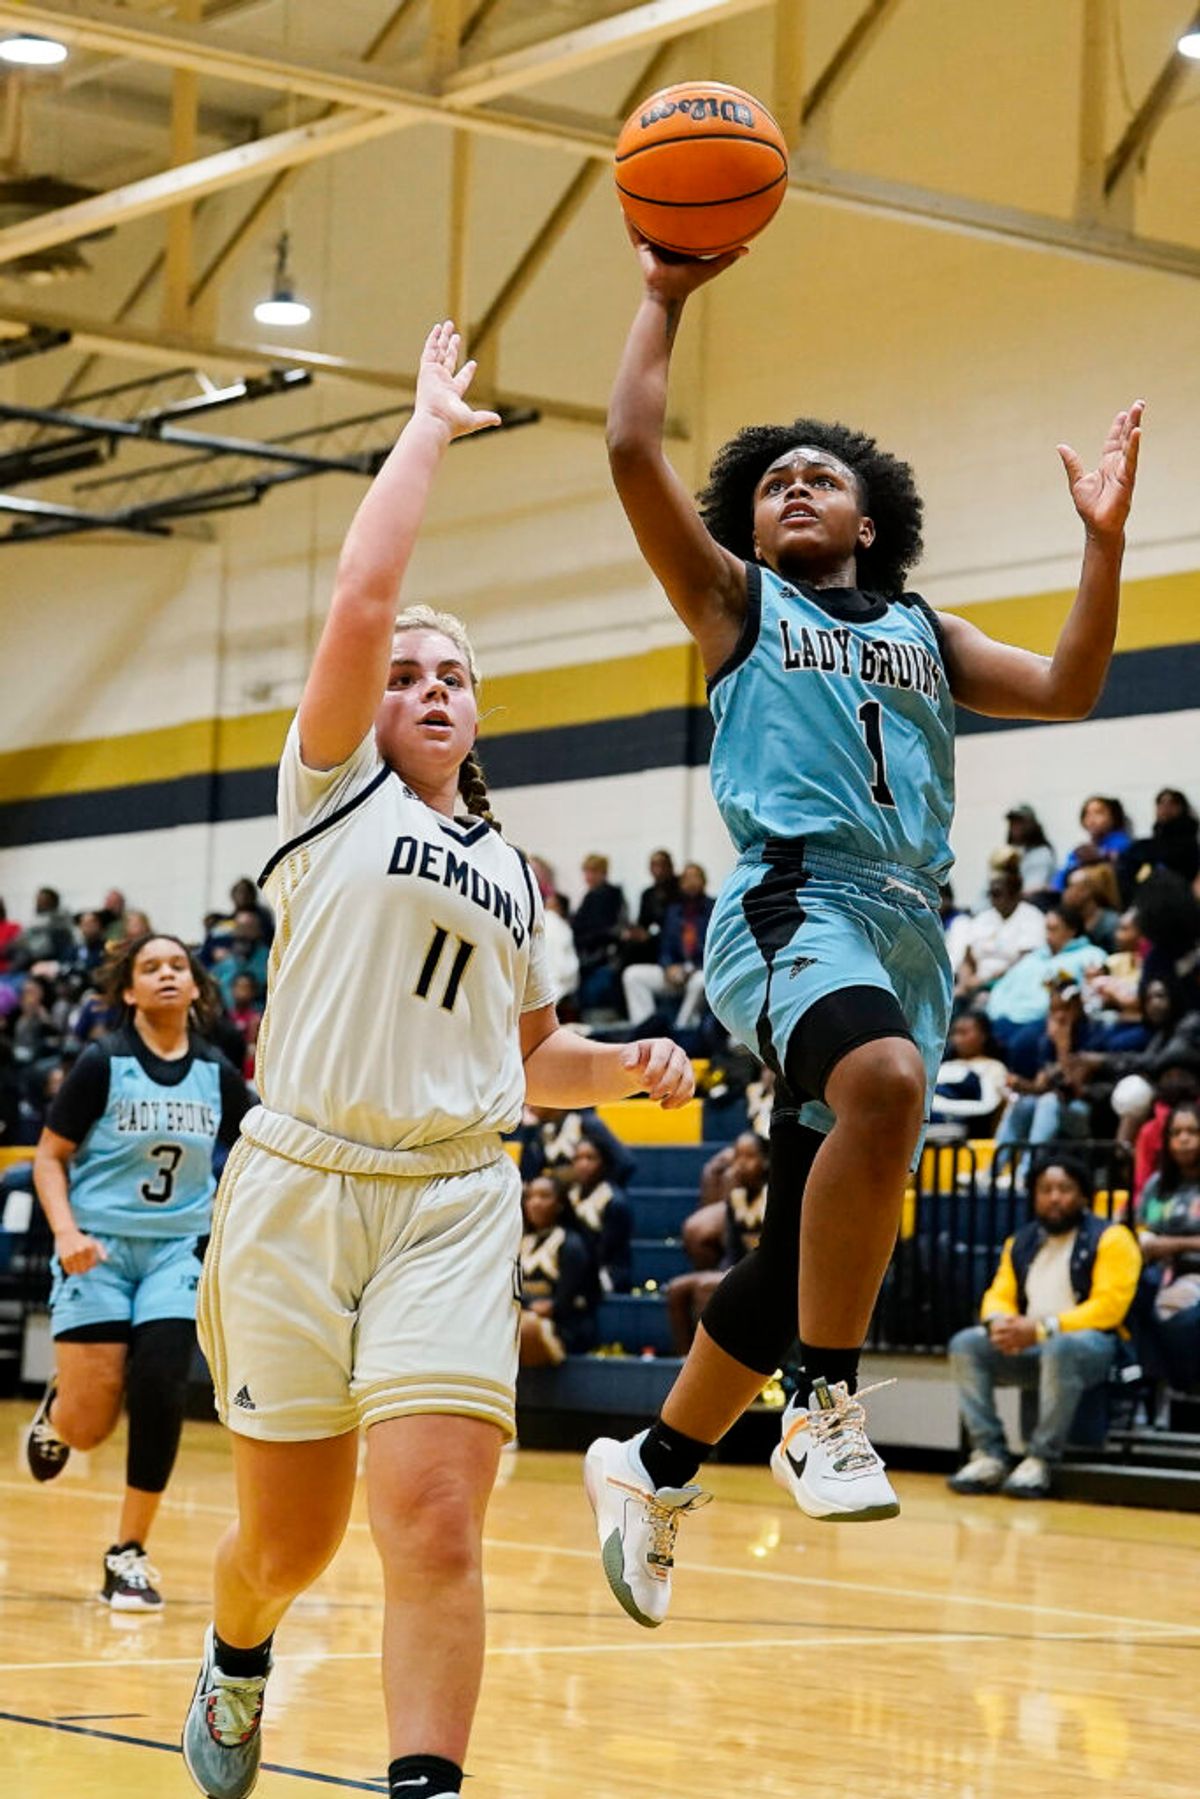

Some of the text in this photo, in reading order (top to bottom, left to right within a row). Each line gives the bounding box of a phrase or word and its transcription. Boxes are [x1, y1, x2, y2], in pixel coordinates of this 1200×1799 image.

[641, 98, 754, 129] Wilson
[779, 620, 850, 676] LADY
[858, 700, 896, 808] 1
[387, 836, 525, 949] DEMONS
[413, 920, 477, 1012] 11
[117, 1101, 215, 1137] LADY BRUINS
[141, 1145, 183, 1203] 3
